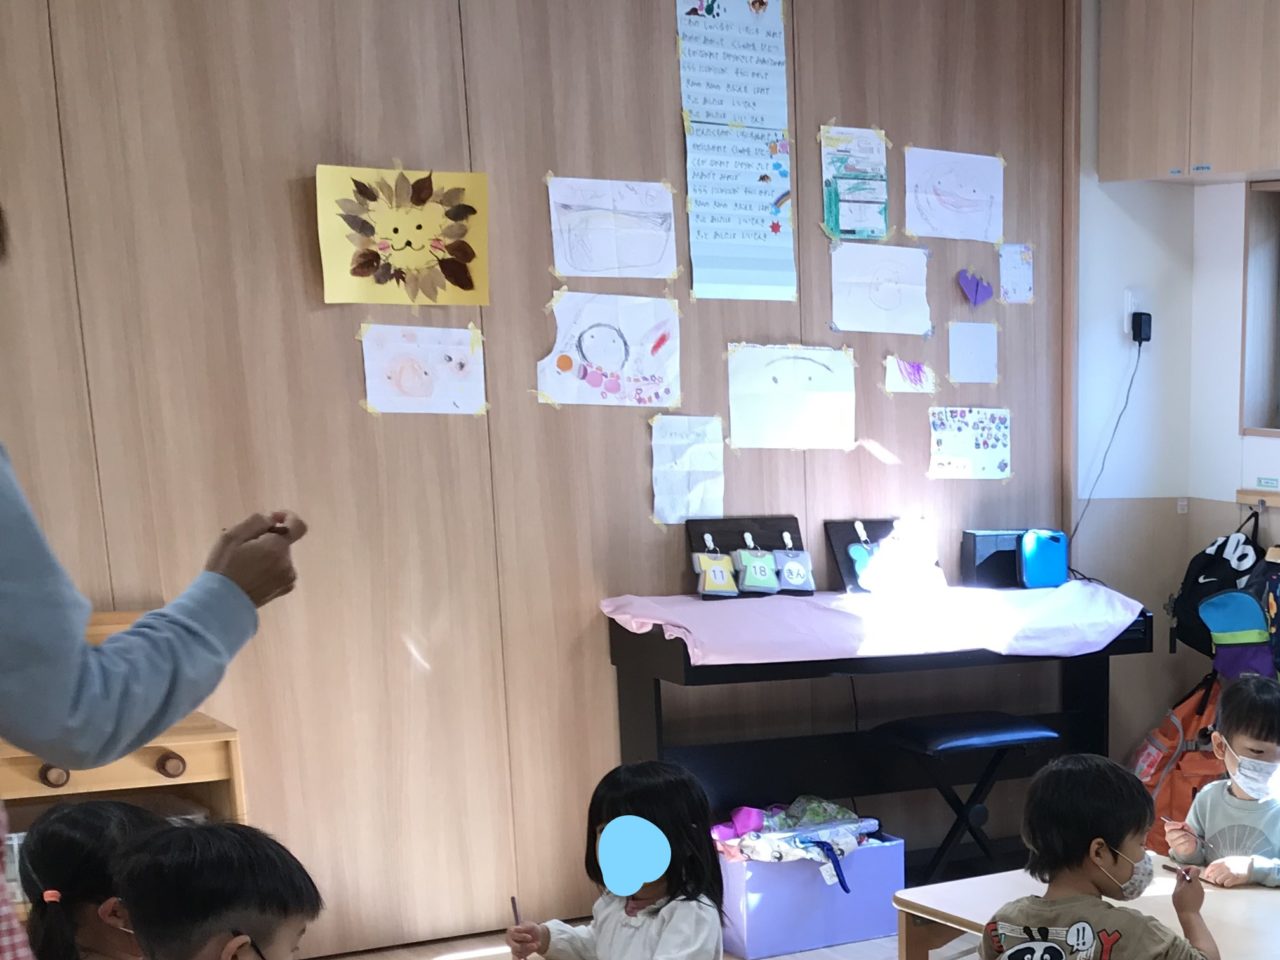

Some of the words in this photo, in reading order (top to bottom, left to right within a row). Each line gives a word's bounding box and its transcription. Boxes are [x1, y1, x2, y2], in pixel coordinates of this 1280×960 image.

[711, 568, 725, 581] 11
[752, 565, 767, 577] 18
[786, 568, 805, 579] きん
